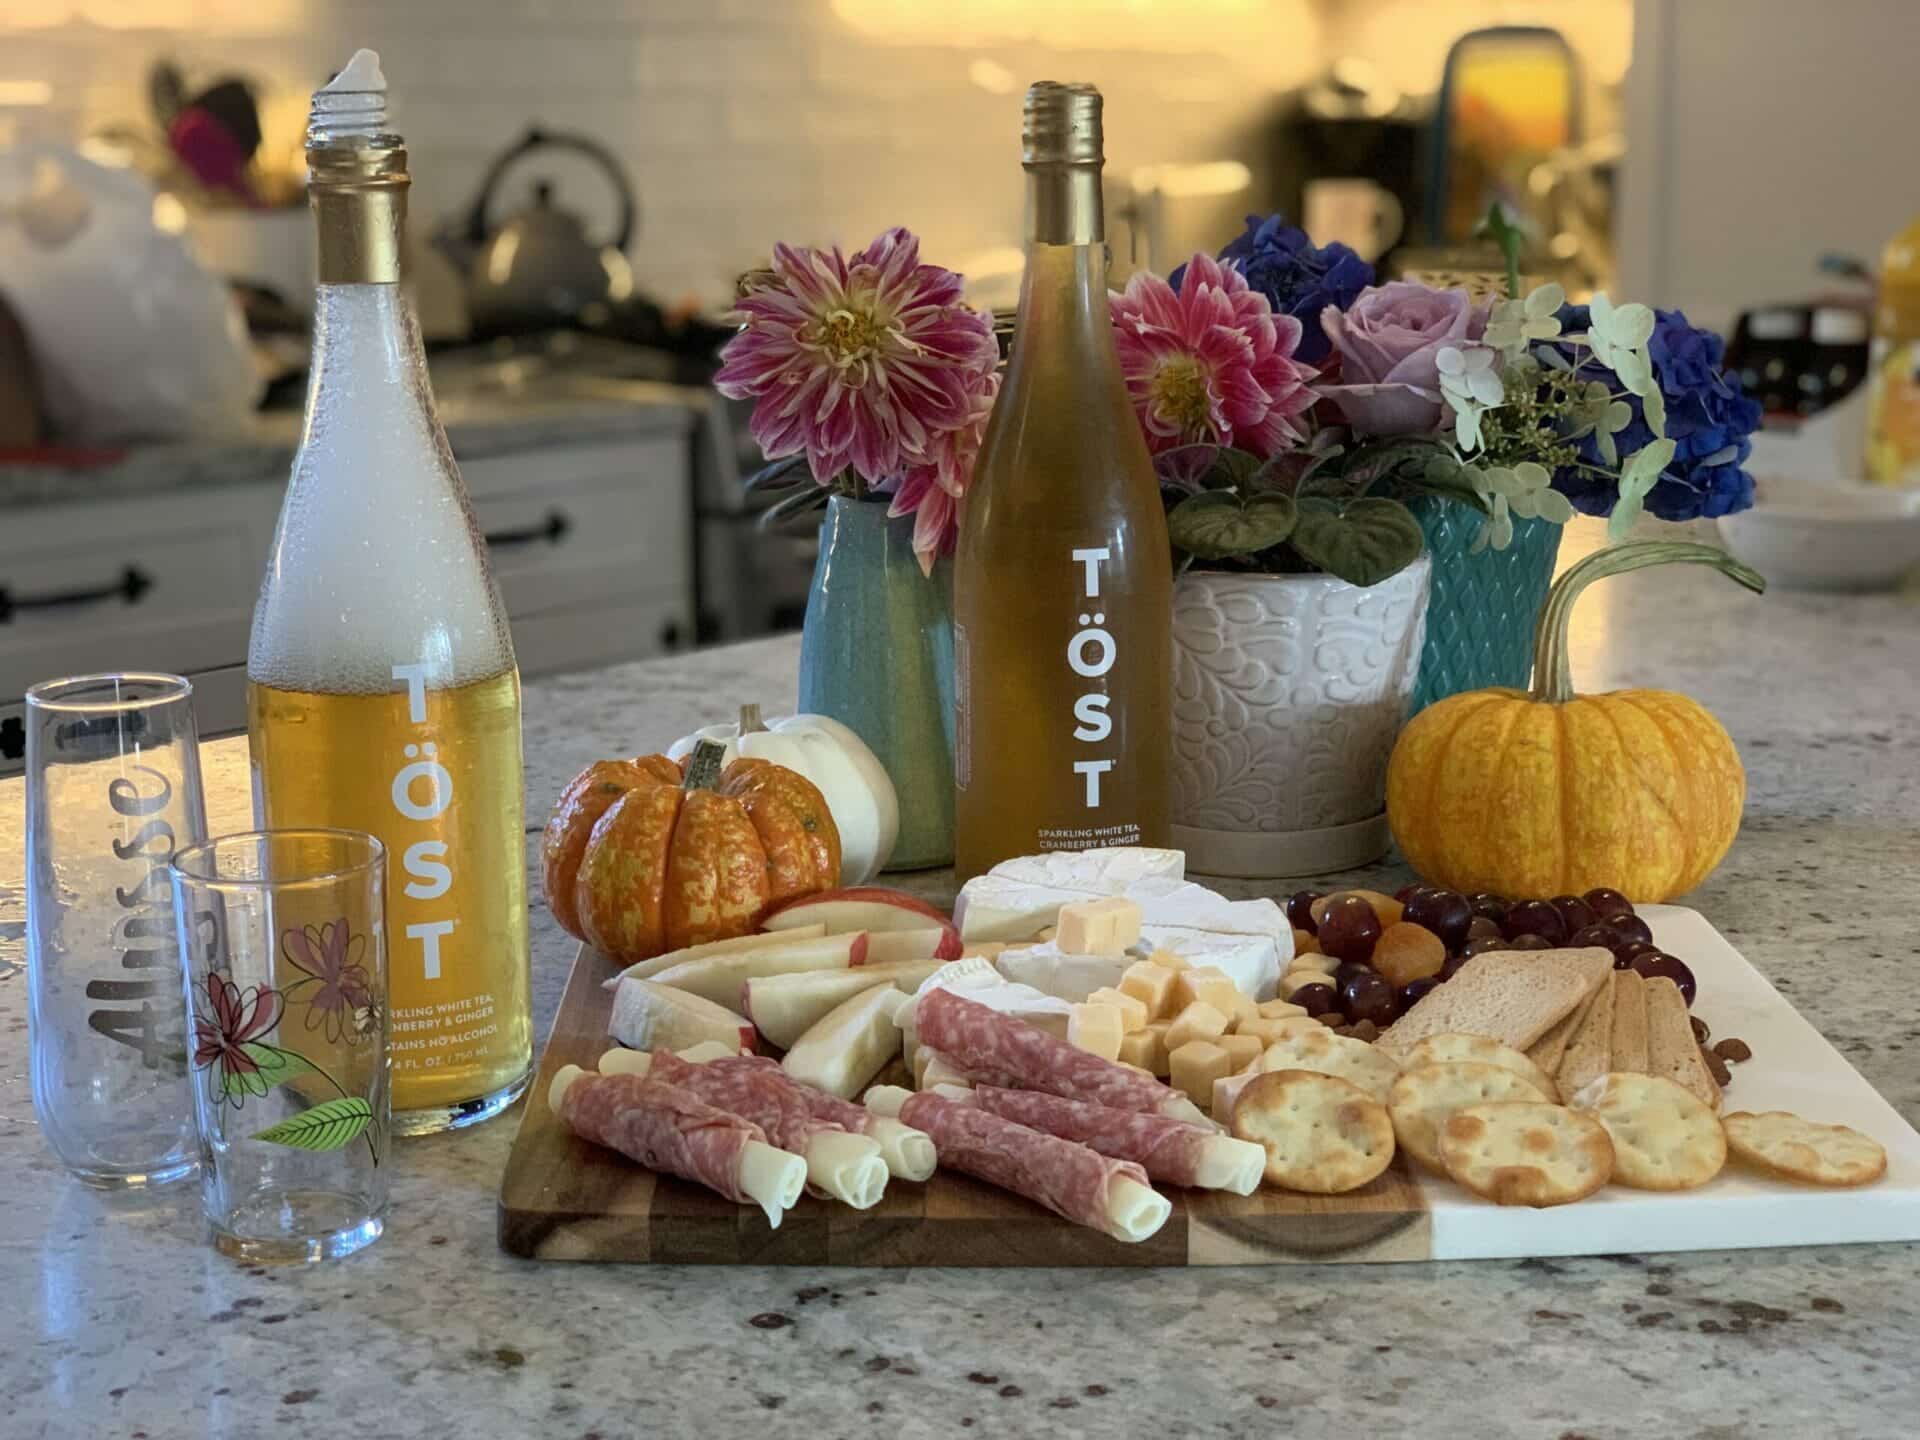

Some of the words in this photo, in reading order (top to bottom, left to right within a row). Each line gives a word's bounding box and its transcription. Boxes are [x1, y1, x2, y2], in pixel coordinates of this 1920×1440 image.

[1067, 548, 1117, 807] TÖST
[391, 663, 454, 980] TÖST
[1038, 828, 1093, 839] SPARKLING
[1094, 825, 1122, 836] WHITE
[1039, 839, 1098, 849] CRANBERRY
[1100, 838, 1107, 848] &
[1108, 833, 1141, 846] GINGER
[390, 1007, 433, 1018] RKLING
[437, 1000, 472, 1012] WHITE
[392, 1019, 441, 1031] NBERRY
[445, 1016, 452, 1026] &
[455, 1006, 494, 1023] GINGER
[390, 1040, 426, 1051] TAINS
[429, 1036, 447, 1047] NO
